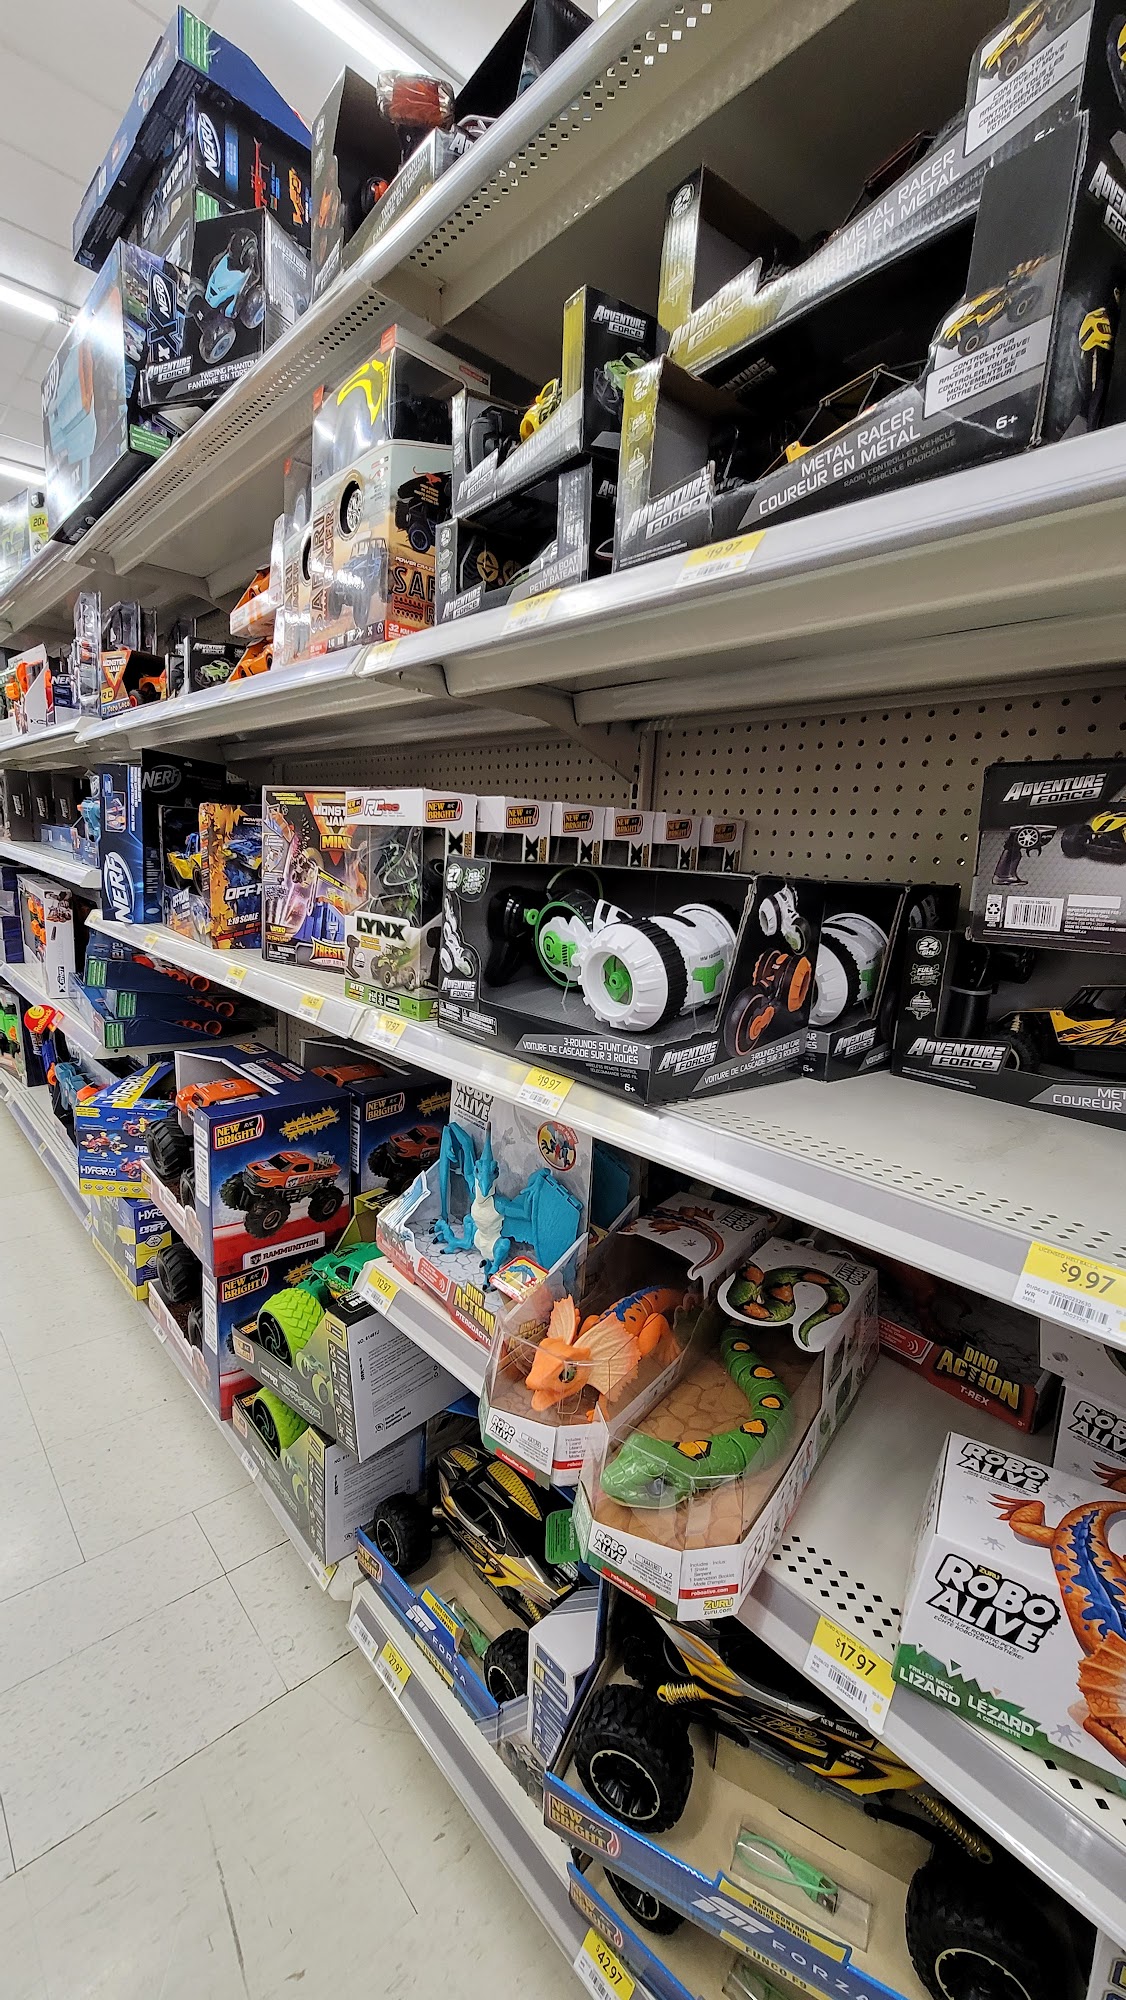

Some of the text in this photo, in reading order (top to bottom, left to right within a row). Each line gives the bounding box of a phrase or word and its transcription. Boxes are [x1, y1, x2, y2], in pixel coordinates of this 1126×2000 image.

[993, 46, 1054, 102] CONTROL YOUR
[197, 112, 221, 179] NERF
[841, 148, 956, 248] METAL RACER
[872, 213, 895, 240] EN
[900, 166, 961, 220] MÉTAL
[152, 273, 172, 320] NERF
[592, 304, 647, 330] ADVENTURE
[607, 322, 644, 340] FORCE
[953, 337, 1015, 372] CONTROL YOUR
[974, 352, 1002, 369] EVERY
[1003, 336, 1031, 356] MOVE!
[987, 356, 1009, 371] TOUS
[1010, 347, 1027, 360] LES
[1005, 359, 1016, 369] DE
[149, 356, 192, 377] ADVENTURE
[158, 366, 191, 384] FORCE
[221, 373, 230, 382] EN
[946, 387, 971, 403] VOTRE
[995, 414, 1019, 430] 6+
[801, 406, 915, 479] METAL RACER
[843, 428, 957, 488] RADIO CONTROLLED VEHICLE
[759, 425, 922, 516] COUREUR EN MÉTAL
[620, 466, 712, 543] ADVENTURE
[646, 491, 709, 540] FORCE
[542, 555, 578, 578] MINI BOAT
[529, 565, 579, 594] PETIT BATEAU
[442, 586, 482, 620] ADVENTURE
[453, 598, 480, 619] FORCE
[101, 690, 113, 699] RC
[142, 765, 182, 793] NERF
[1003, 772, 1107, 803] ADVENTURE
[427, 802, 445, 812] NEW
[1030, 787, 1102, 806] FORCE
[428, 810, 456, 820] BRIGHT
[508, 808, 524, 818] NEW
[508, 816, 533, 826] BRIGHT
[564, 813, 579, 822] NEW
[564, 820, 588, 831] BRIGHT
[103, 851, 135, 923] NERF
[447, 868, 460, 882] 27
[356, 916, 408, 942] LYNX
[441, 977, 476, 991] ADVENTURE
[450, 989, 475, 1000] FORCE
[523, 1041, 639, 1065] VOITURE DE CASCADE SUR 3 ROUES
[563, 1037, 639, 1055] 3-ROUNDS STUNT CAR
[834, 1028, 877, 1054] ADVENTURE
[907, 1037, 1006, 1059] ADVENTURE
[659, 1040, 719, 1071] ADVENTURE
[673, 1054, 713, 1076] FORCE
[704, 1071, 730, 1085] VOITURE
[730, 1066, 739, 1076] DE
[740, 1058, 766, 1073] CASCADE
[766, 1054, 778, 1065] SUR
[783, 1047, 800, 1060] ROUES
[932, 1054, 1001, 1072] FORCE
[537, 1074, 562, 1091] $19.97
[624, 1082, 636, 1092] 6+
[1097, 1088, 1126, 1100] MET
[367, 1104, 399, 1118] BRIGHT
[368, 1100, 386, 1111] NEW
[454, 1092, 491, 1122] ALIVE
[1053, 1094, 1123, 1111] COUREUR
[217, 1120, 254, 1137] NEW R/C
[217, 1128, 256, 1147] BRIGHT
[262, 1237, 320, 1260] RAMMUNITION
[1038, 1246, 1065, 1259] LICENSED
[223, 1277, 243, 1291] NEW
[1060, 1261, 1117, 1294] $9.97
[223, 1280, 261, 1301] BRIGHT
[466, 1282, 486, 1303] DINO
[1024, 1289, 1036, 1298] WR
[453, 1288, 497, 1336] ACTION
[455, 1309, 493, 1347] PTERODACTYL
[964, 1346, 999, 1373] DINO
[936, 1350, 1020, 1410] ACTION
[960, 1385, 990, 1407] T-REX
[490, 1424, 515, 1444] ALIVE
[491, 1414, 516, 1437] ROBO
[961, 1442, 1050, 1482] ROBO
[958, 1456, 1042, 1494] ALIVE
[593, 1541, 624, 1565] ALIVE
[595, 1529, 628, 1555] ROBO
[979, 1565, 1000, 1581] ZURU
[690, 1587, 729, 1597] roboalive.com
[935, 1553, 1062, 1624] ROBO
[703, 1597, 734, 1611] ZURU
[703, 1608, 732, 1616] zuru.com
[926, 1592, 1054, 1654] ALIVE
[939, 1613, 1020, 1654] REAL-LIFE ROBOTIC PETS!
[933, 1614, 1025, 1661] ECHTE ROBOTER-HAUSTIERE!
[432, 1634, 468, 1687] FORZA
[834, 1638, 877, 1677] $17.97
[899, 1666, 961, 1707] LIZARD
[908, 1664, 954, 1691] FRILLED NECK
[820, 1716, 860, 1739] NEW BRIGHT
[967, 1694, 1035, 1738] LÉZARD
[982, 1715, 1021, 1739] COLLERETTE
[550, 1797, 604, 1836] NEW R/C
[551, 1810, 607, 1850] BRIGHT
[749, 1903, 812, 1944] RADIOCOMMANDE
[752, 1898, 810, 1938] RADIO CONTROL
[596, 1944, 624, 1986] $42.97
[745, 1946, 808, 1990] FUNCO F9
